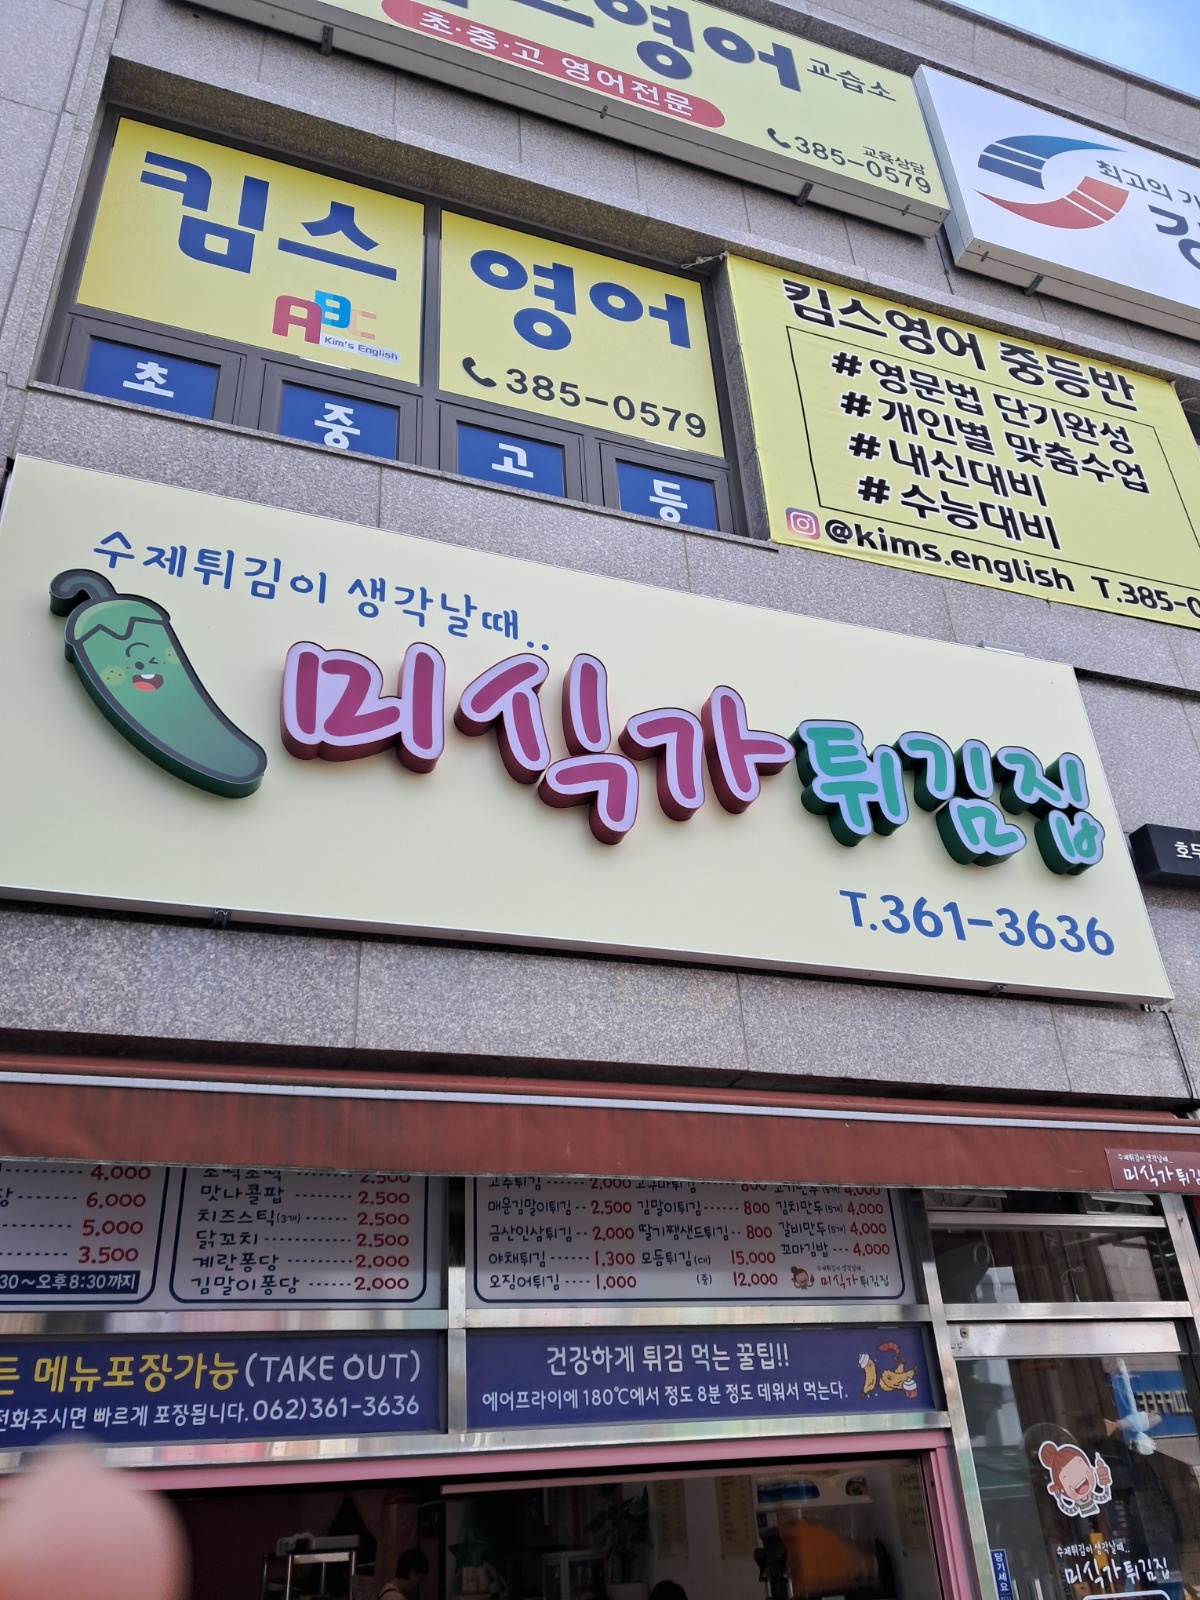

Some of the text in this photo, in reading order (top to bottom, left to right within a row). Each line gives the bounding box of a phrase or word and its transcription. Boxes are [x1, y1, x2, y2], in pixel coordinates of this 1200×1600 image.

[562, 57, 693, 117] 영어전문
[807, 57, 896, 102] 교습소
[793, 136, 931, 194] 385-0579
[862, 145, 925, 175] 교육상담
[1096, 160, 1174, 201] 최고의
[140, 151, 397, 281] 킴스
[470, 250, 691, 350] 영어
[324, 336, 398, 361] Kim's English
[782, 279, 1138, 412] 킴스영어 중등반
[506, 368, 706, 438] 385-0579
[123, 361, 688, 523] 초 중 고 등
[993, 393, 1135, 455] 단기완성
[1004, 431, 1150, 494] 맞춤수업
[94, 531, 327, 604] 수제튀김이
[825, 518, 1075, 593] @kims.english
[279, 641, 1105, 876] 미식가 튀김집
[839, 890, 1115, 956] T.361-3636
[1123, 1164, 1174, 1187] 미식가
[200, 1184, 284, 1205] 맛나콜팝
[488, 1197, 572, 1216] 매운김말이튀김
[637, 1200, 701, 1216] 김말이튀김
[744, 1200, 770, 1215] 800
[196, 1230, 258, 1249] 닭꼬치
[489, 1225, 572, 1243] 금산인삼튀김
[746, 1225, 772, 1240] 800
[192, 1252, 279, 1272] 계란퐁당
[489, 1251, 546, 1268] 야채튀김
[780, 1241, 829, 1258] 꼬마김밥
[191, 1275, 300, 1296] 김말이퐁당
[489, 1274, 559, 1291] 오징어튀김
[820, 1273, 858, 1290] 미식가
[547, 1343, 789, 1375] 건강하게 튀김 먹는 꿀팁!!
[482, 1389, 578, 1412] 에어프라이에
[664, 1385, 693, 1407] 정도
[698, 1384, 721, 1404] 8분
[726, 1383, 754, 1404] 정도
[757, 1382, 800, 1402] 데워서
[93, 1405, 148, 1428] 빠르게
[994, 1552, 1009, 1592] 당기세요
[1064, 1558, 1122, 1589] 미식가
[1123, 1557, 1170, 1584] 튀김집
